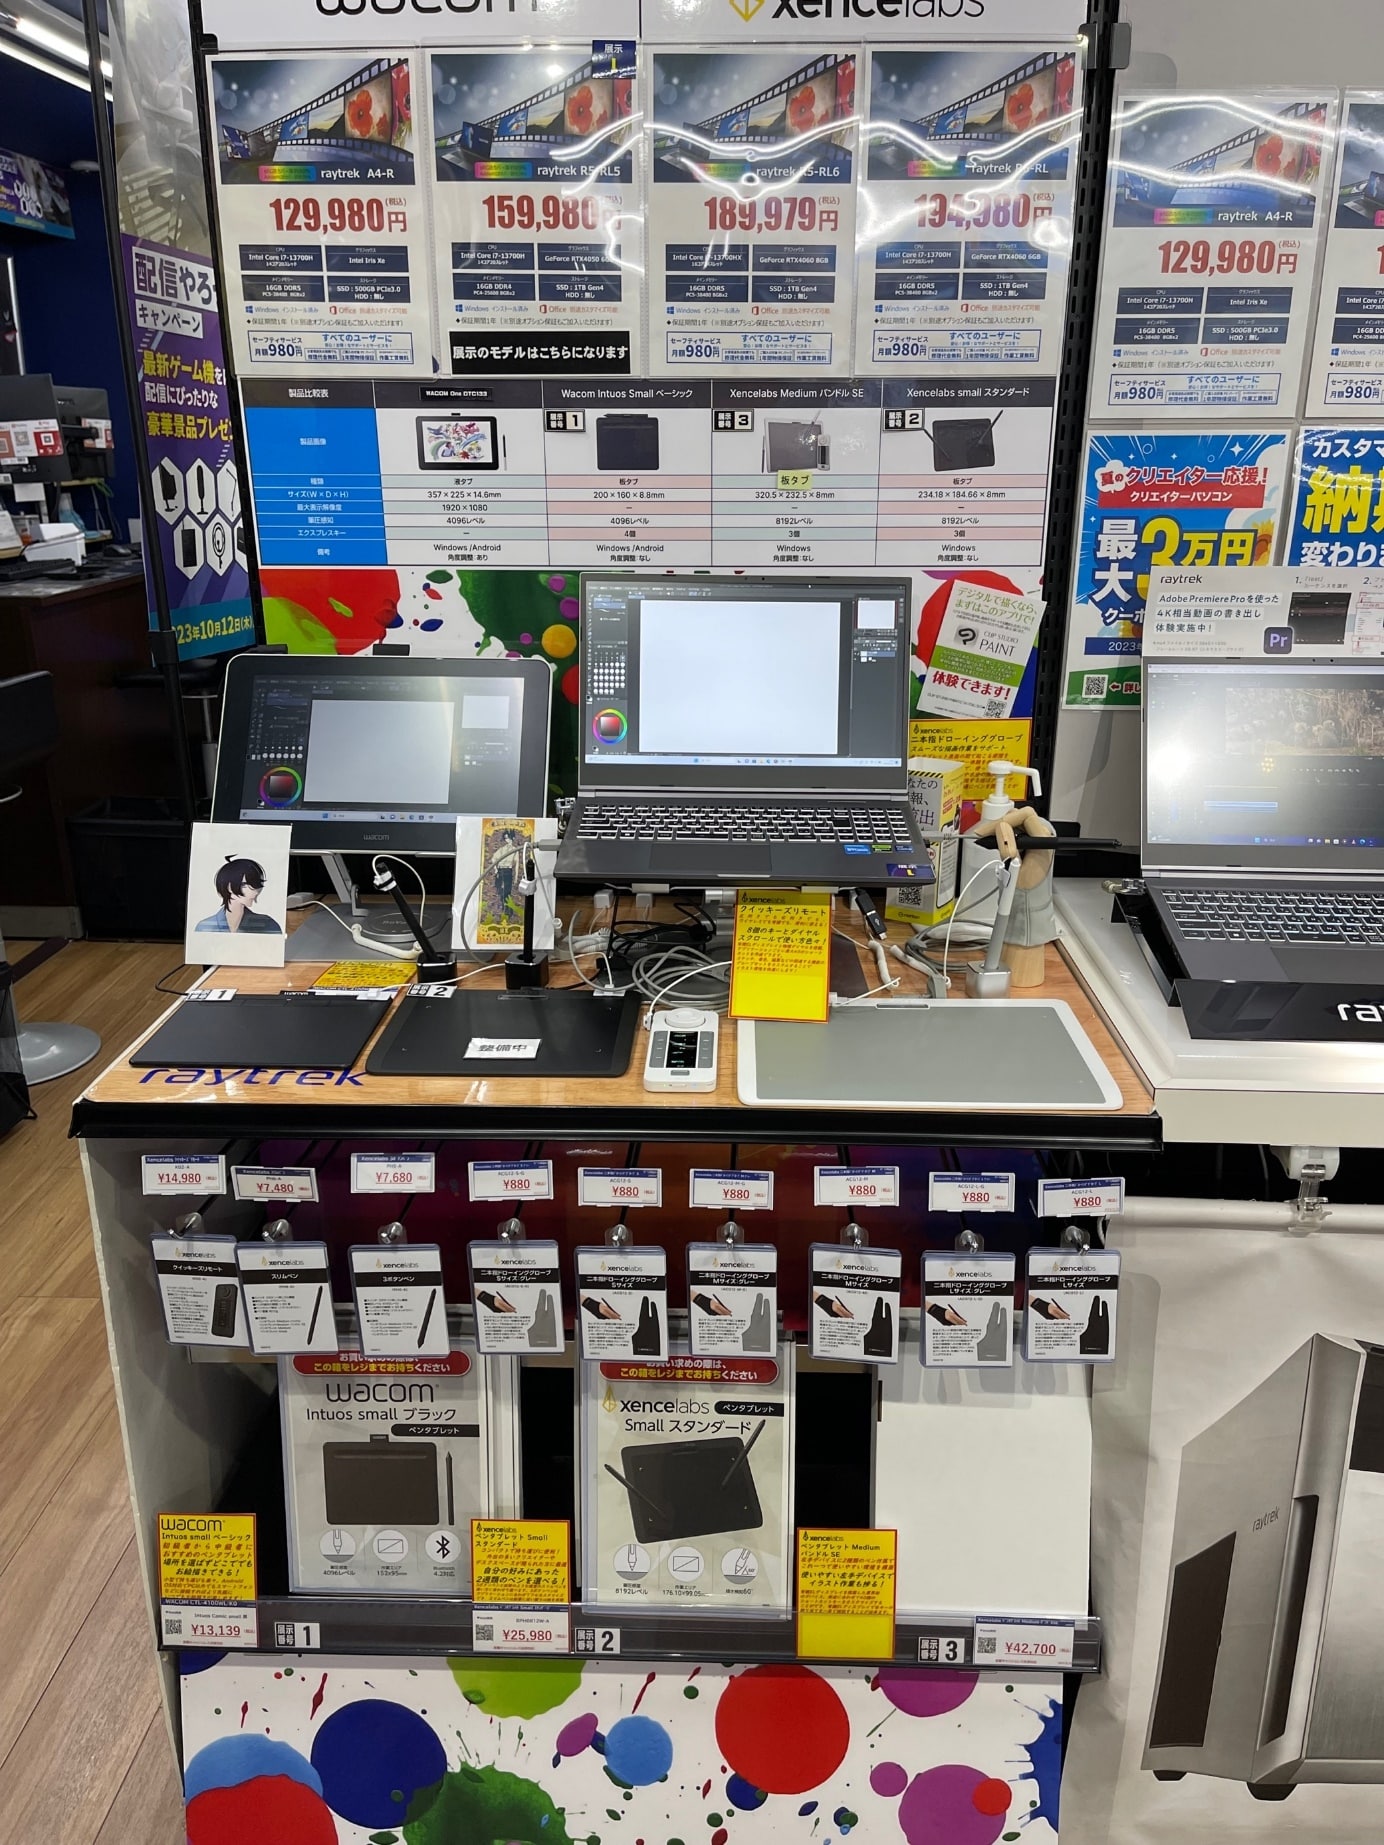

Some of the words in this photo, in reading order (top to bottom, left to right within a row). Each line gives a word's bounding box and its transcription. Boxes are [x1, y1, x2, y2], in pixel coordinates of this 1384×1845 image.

[321, 169, 360, 179] raytrek
[367, 169, 394, 178] A4-R
[537, 165, 576, 177] raytrek
[580, 165, 621, 176] R5RL5
[757, 166, 795, 178] raytrek
[800, 167, 840, 176] 5-RL6
[971, 164, 1011, 175] raytrek
[1218, 211, 1257, 222] raytrek
[1265, 211, 1293, 221] A4-R
[135, 252, 216, 305] 配信やろ
[138, 303, 201, 333] キャンペーン
[322, 334, 392, 342] すべてのユーザーに
[742, 335, 812, 343] すべてのユーザーに
[950, 332, 1020, 340] すべてのユーザーに
[453, 346, 628, 359] 展示のモデルはこちらになります
[142, 350, 226, 386] 最新ゲーム機を
[1188, 375, 1259, 384] すべてのユーザーに
[144, 381, 218, 408] 配信にぴったりな
[288, 388, 329, 398] 製品比較表
[561, 389, 596, 398] Wacom
[598, 389, 627, 398] Intuos
[629, 389, 653, 398] Small
[656, 389, 693, 398] ベーシック
[730, 389, 777, 398] Xencelabs
[780, 389, 817, 398] Medium
[820, 389, 850, 398] バンドル
[852, 389, 864, 398] SE
[907, 388, 955, 397] Xencelabs
[958, 388, 981, 397] small
[985, 388, 1029, 397] スタンダード
[572, 414, 579, 427] 1
[738, 414, 749, 426] 3
[908, 413, 920, 424] 2
[781, 476, 809, 485] 板タブ
[953, 477, 972, 485] 板タブ
[1130, 491, 1232, 502] クリエイターパソコン
[610, 517, 649, 525] 4096レベル
[1160, 575, 1202, 584] raytrek
[1159, 595, 1188, 603] Adobe
[1189, 595, 1229, 603] Premiere
[1157, 609, 1262, 618] 4K相当動画の書き出し
[1270, 634, 1288, 647] Pr
[980, 639, 1015, 657] PAINT
[932, 671, 1011, 700] 体験できます!
[911, 735, 1023, 743] 二本指ドローインググローブ
[740, 906, 826, 916] クイッキーズリモート
[435, 986, 448, 997] 2
[1337, 1004, 1384, 1022] ra
[478, 1044, 528, 1053] 整備中
[139, 1068, 369, 1087] raytrek
[158, 1173, 201, 1184] ¥14,980
[376, 1172, 413, 1183] ¥7,680
[257, 1183, 294, 1193] ¥7,480
[503, 1179, 530, 1190] ¥880
[612, 1186, 639, 1197] ¥880
[723, 1189, 750, 1200] ¥880
[849, 1185, 876, 1196] ¥880
[963, 1192, 990, 1203] ¥880
[1073, 1196, 1101, 1207] ¥880
[843, 1263, 879, 1272] xencelabs
[1060, 1264, 1096, 1272] xencelabs
[956, 1270, 993, 1278] xencelabs
[314, 1363, 450, 1372] この箱をレジまでお持ちください
[621, 1368, 757, 1380] この箱をレジまでお持ちください
[325, 1383, 435, 1403] wacom
[620, 1398, 709, 1414] xencelabs
[723, 1405, 775, 1413] ペンタブレット
[307, 1408, 352, 1420] Intuos
[358, 1408, 398, 1420] small
[404, 1408, 456, 1421] ブラック
[625, 1419, 664, 1432] Small
[669, 1420, 751, 1434] スタンダード
[1253, 1506, 1280, 1532] raytrek
[161, 1519, 222, 1531] wacom
[192, 1624, 240, 1636] ¥13,139
[503, 1630, 552, 1640] ¥25,980
[303, 1626, 310, 1646] 1
[601, 1631, 614, 1651] 2
[945, 1640, 958, 1661] 3
[1005, 1641, 1056, 1655] ¥42,700
